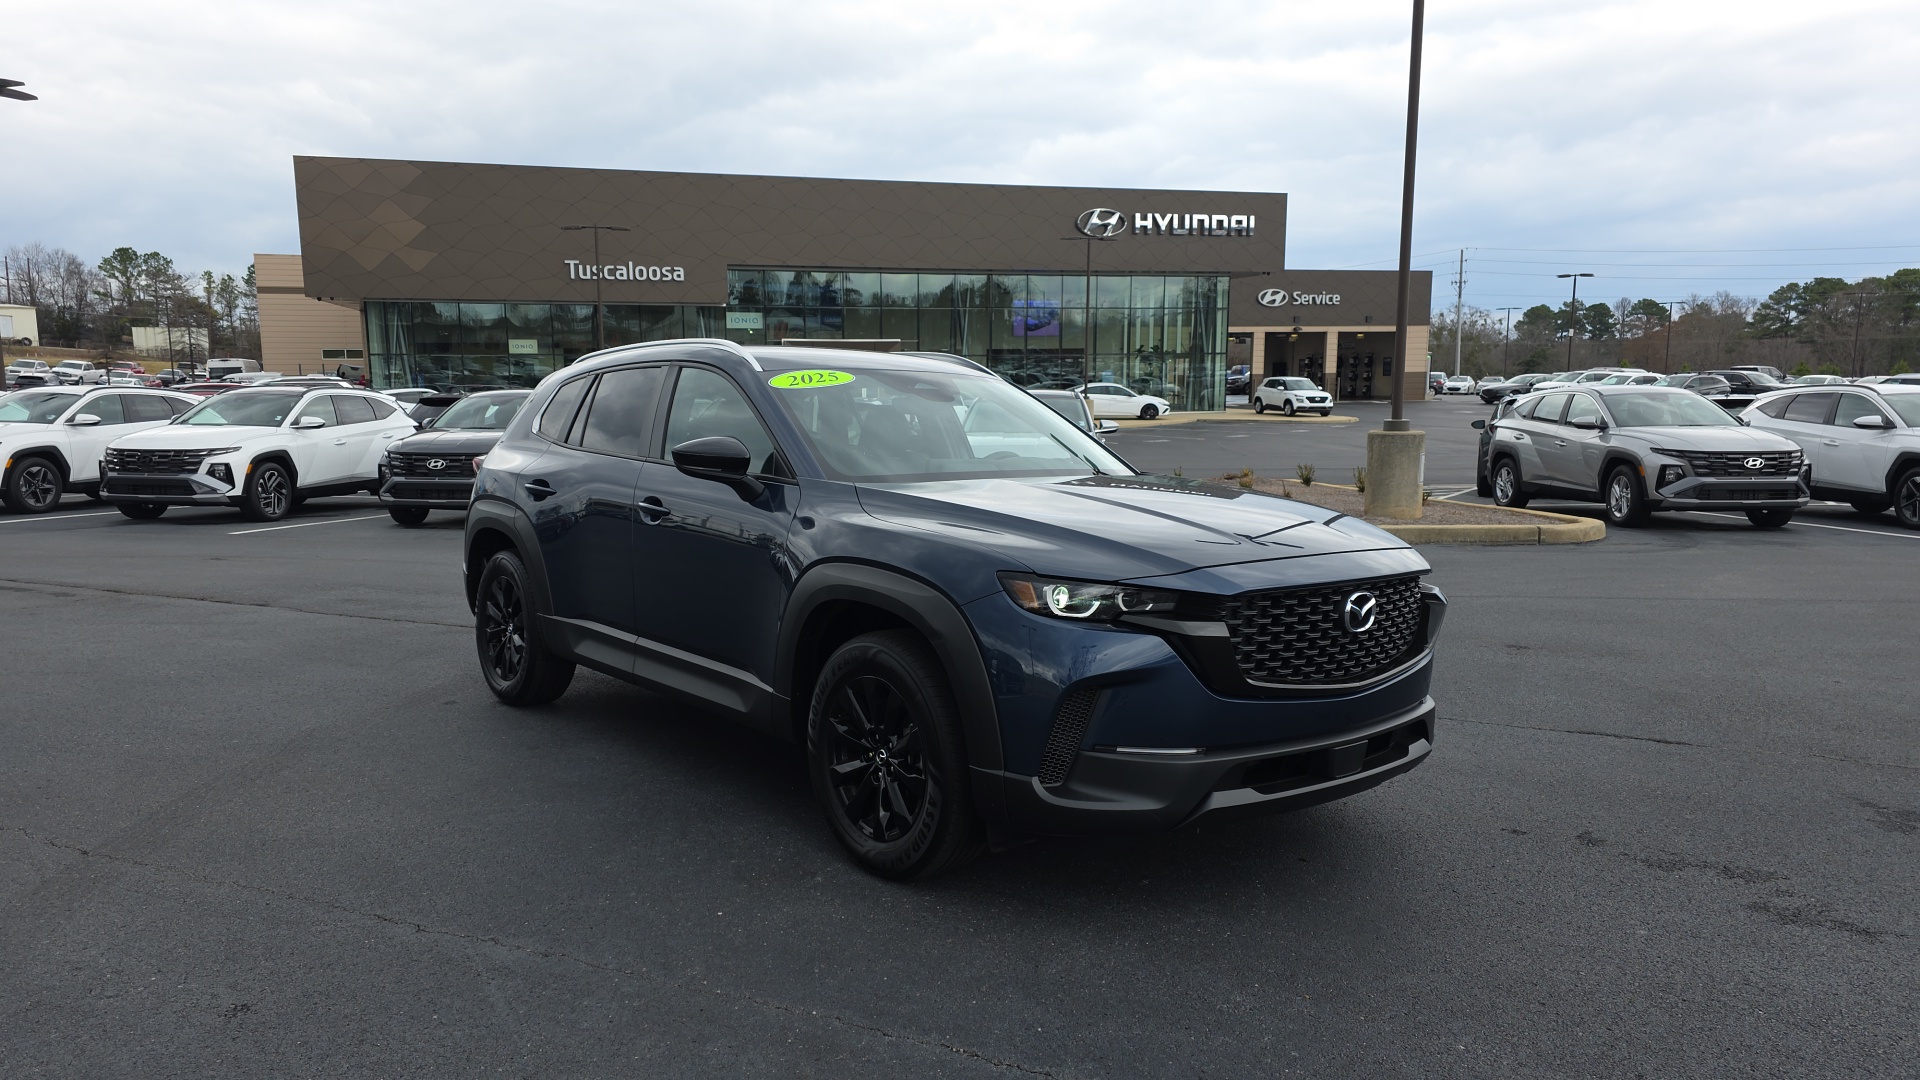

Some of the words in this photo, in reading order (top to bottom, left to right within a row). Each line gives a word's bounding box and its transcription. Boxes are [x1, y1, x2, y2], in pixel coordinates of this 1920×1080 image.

[1134, 213, 1256, 236] HYUNDAI
[564, 259, 685, 282] Tuscaloosa
[1292, 291, 1341, 305] Service
[786, 372, 839, 387] 2025
[880, 792, 937, 868] ASSURAN
